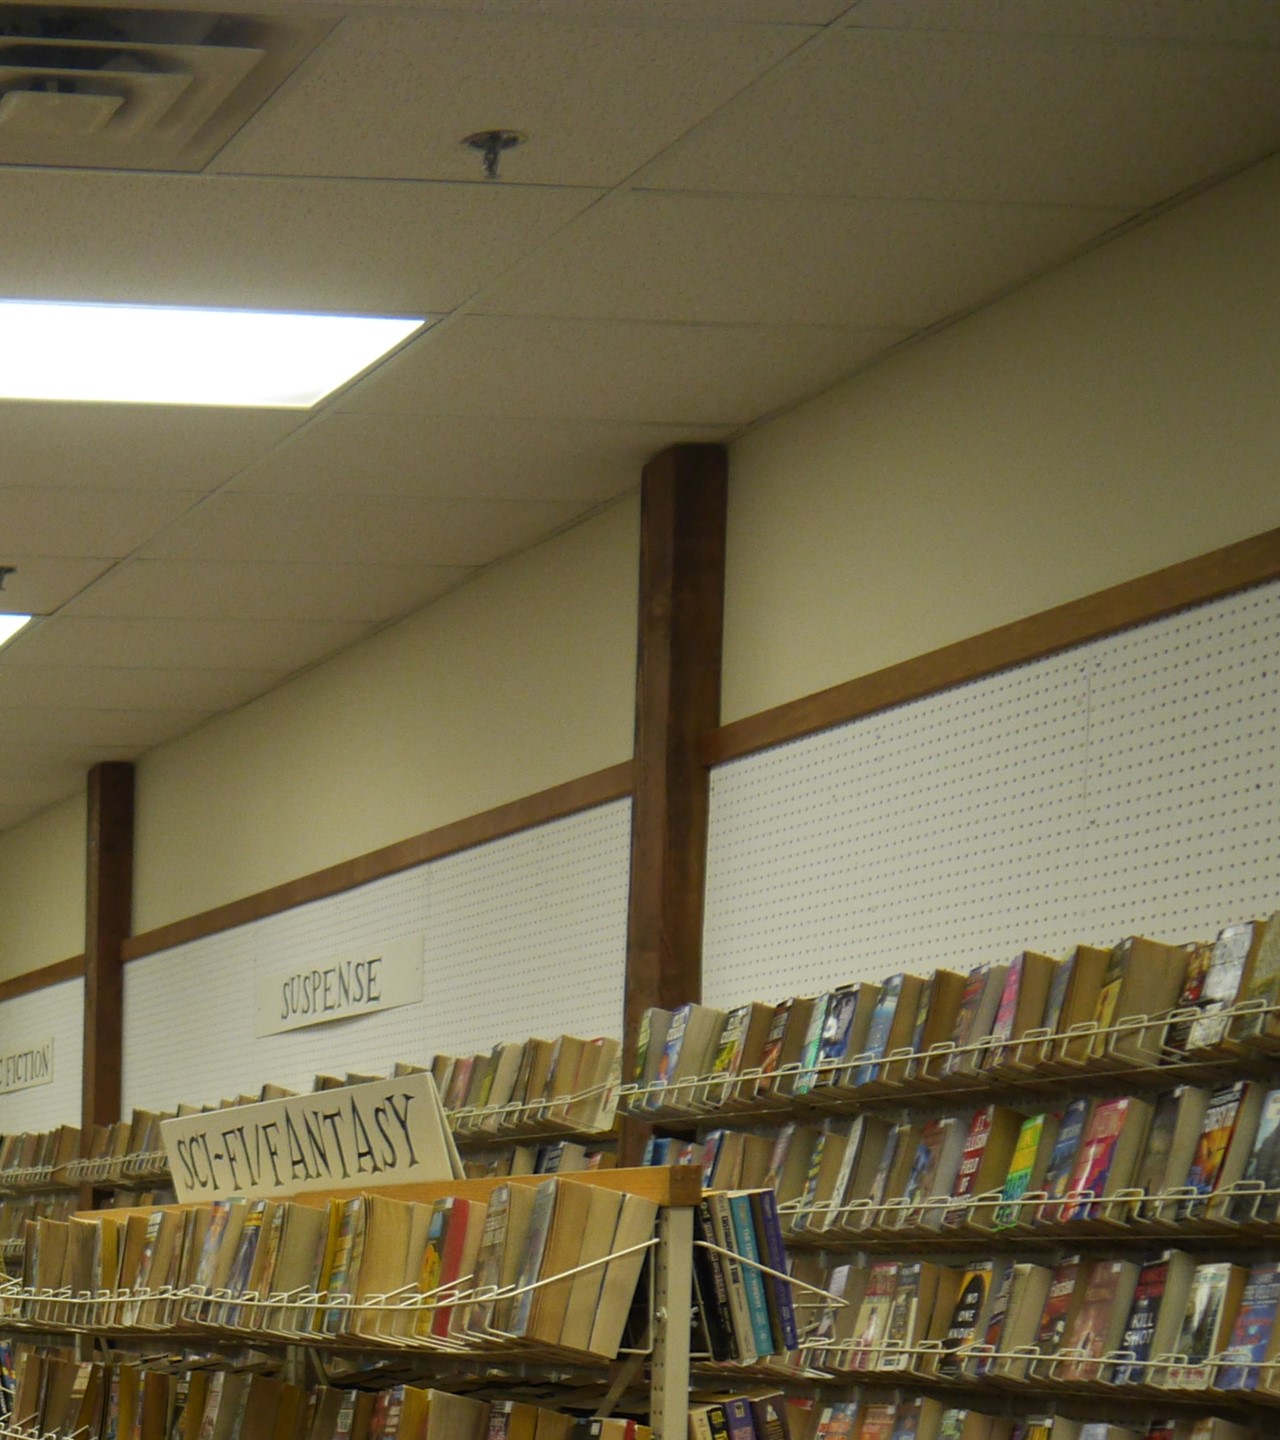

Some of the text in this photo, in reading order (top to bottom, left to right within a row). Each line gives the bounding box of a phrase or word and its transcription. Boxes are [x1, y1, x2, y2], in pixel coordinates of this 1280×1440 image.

[281, 956, 383, 1020] SUSPENSE
[6, 1044, 50, 1087] FICTION
[177, 1093, 421, 1191] SCI-FI/FANTASY
[965, 1291, 979, 1304] NO
[957, 1310, 976, 1322] ONE
[1131, 1312, 1155, 1329] KILL
[1123, 1330, 1155, 1347] SHOT
